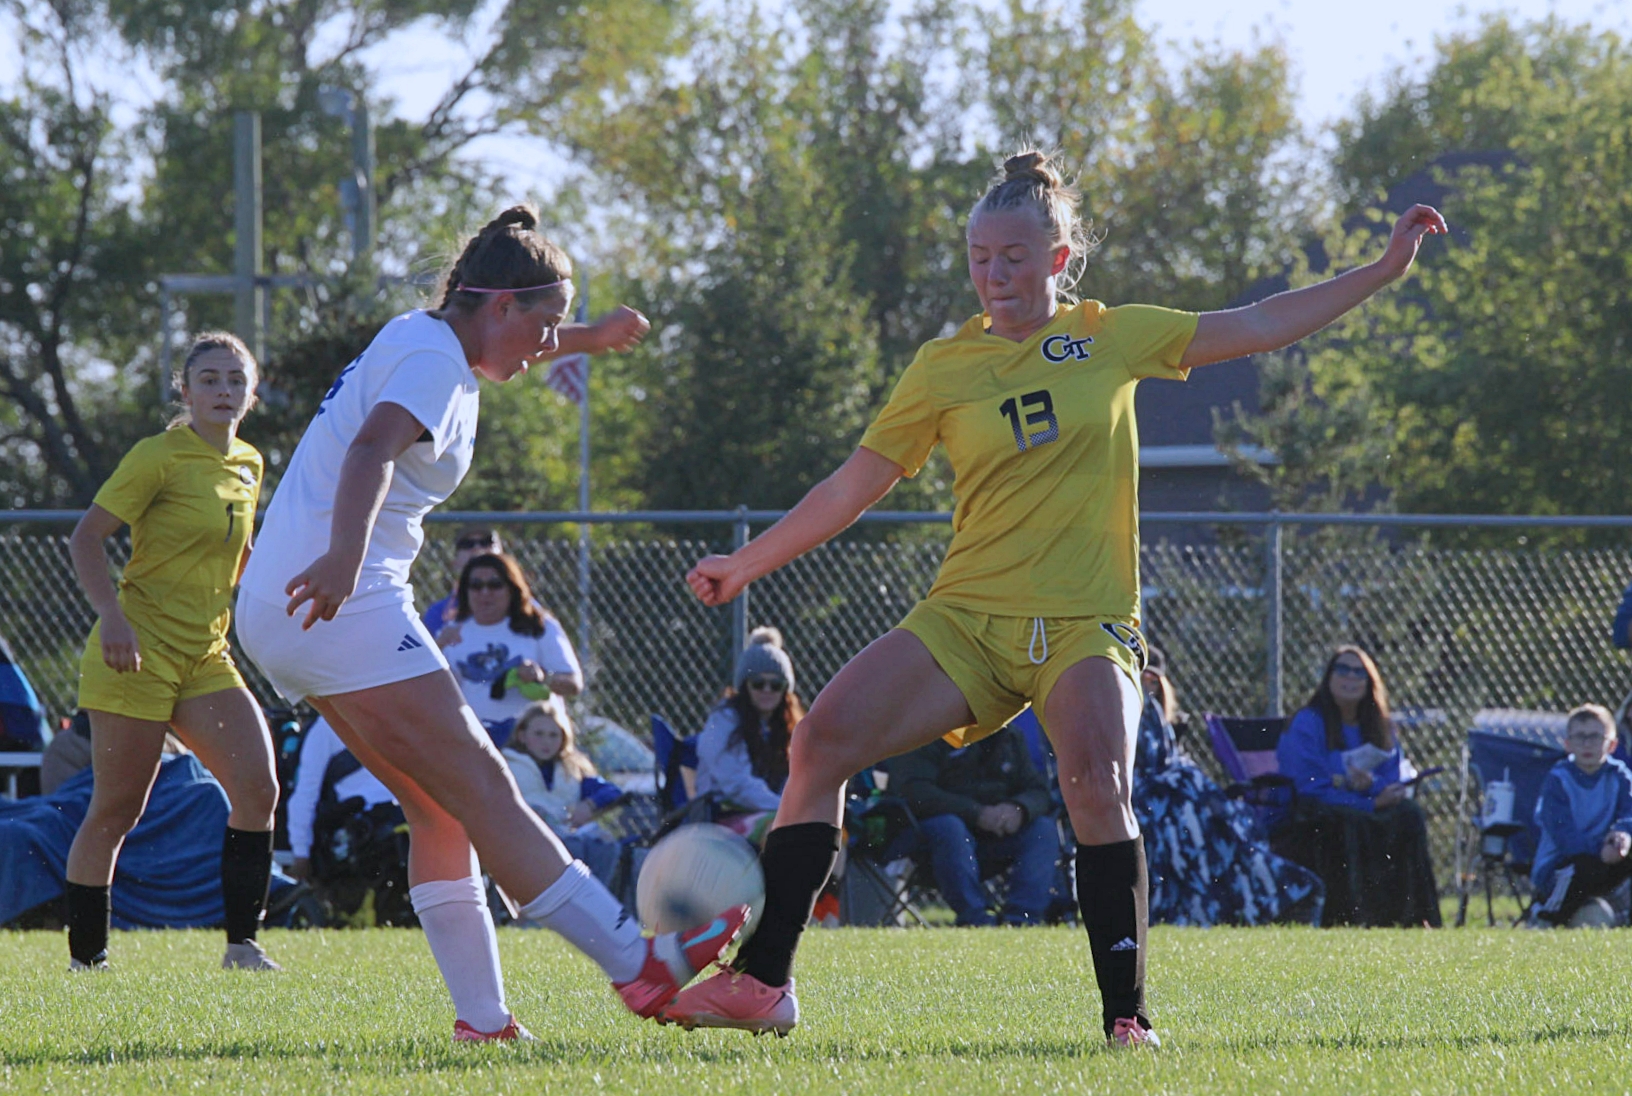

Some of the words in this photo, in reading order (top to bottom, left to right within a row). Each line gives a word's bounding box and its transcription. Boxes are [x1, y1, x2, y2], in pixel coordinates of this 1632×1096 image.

[1041, 333, 1094, 363] GT
[999, 389, 1059, 452] 13
[224, 502, 234, 543] 1
